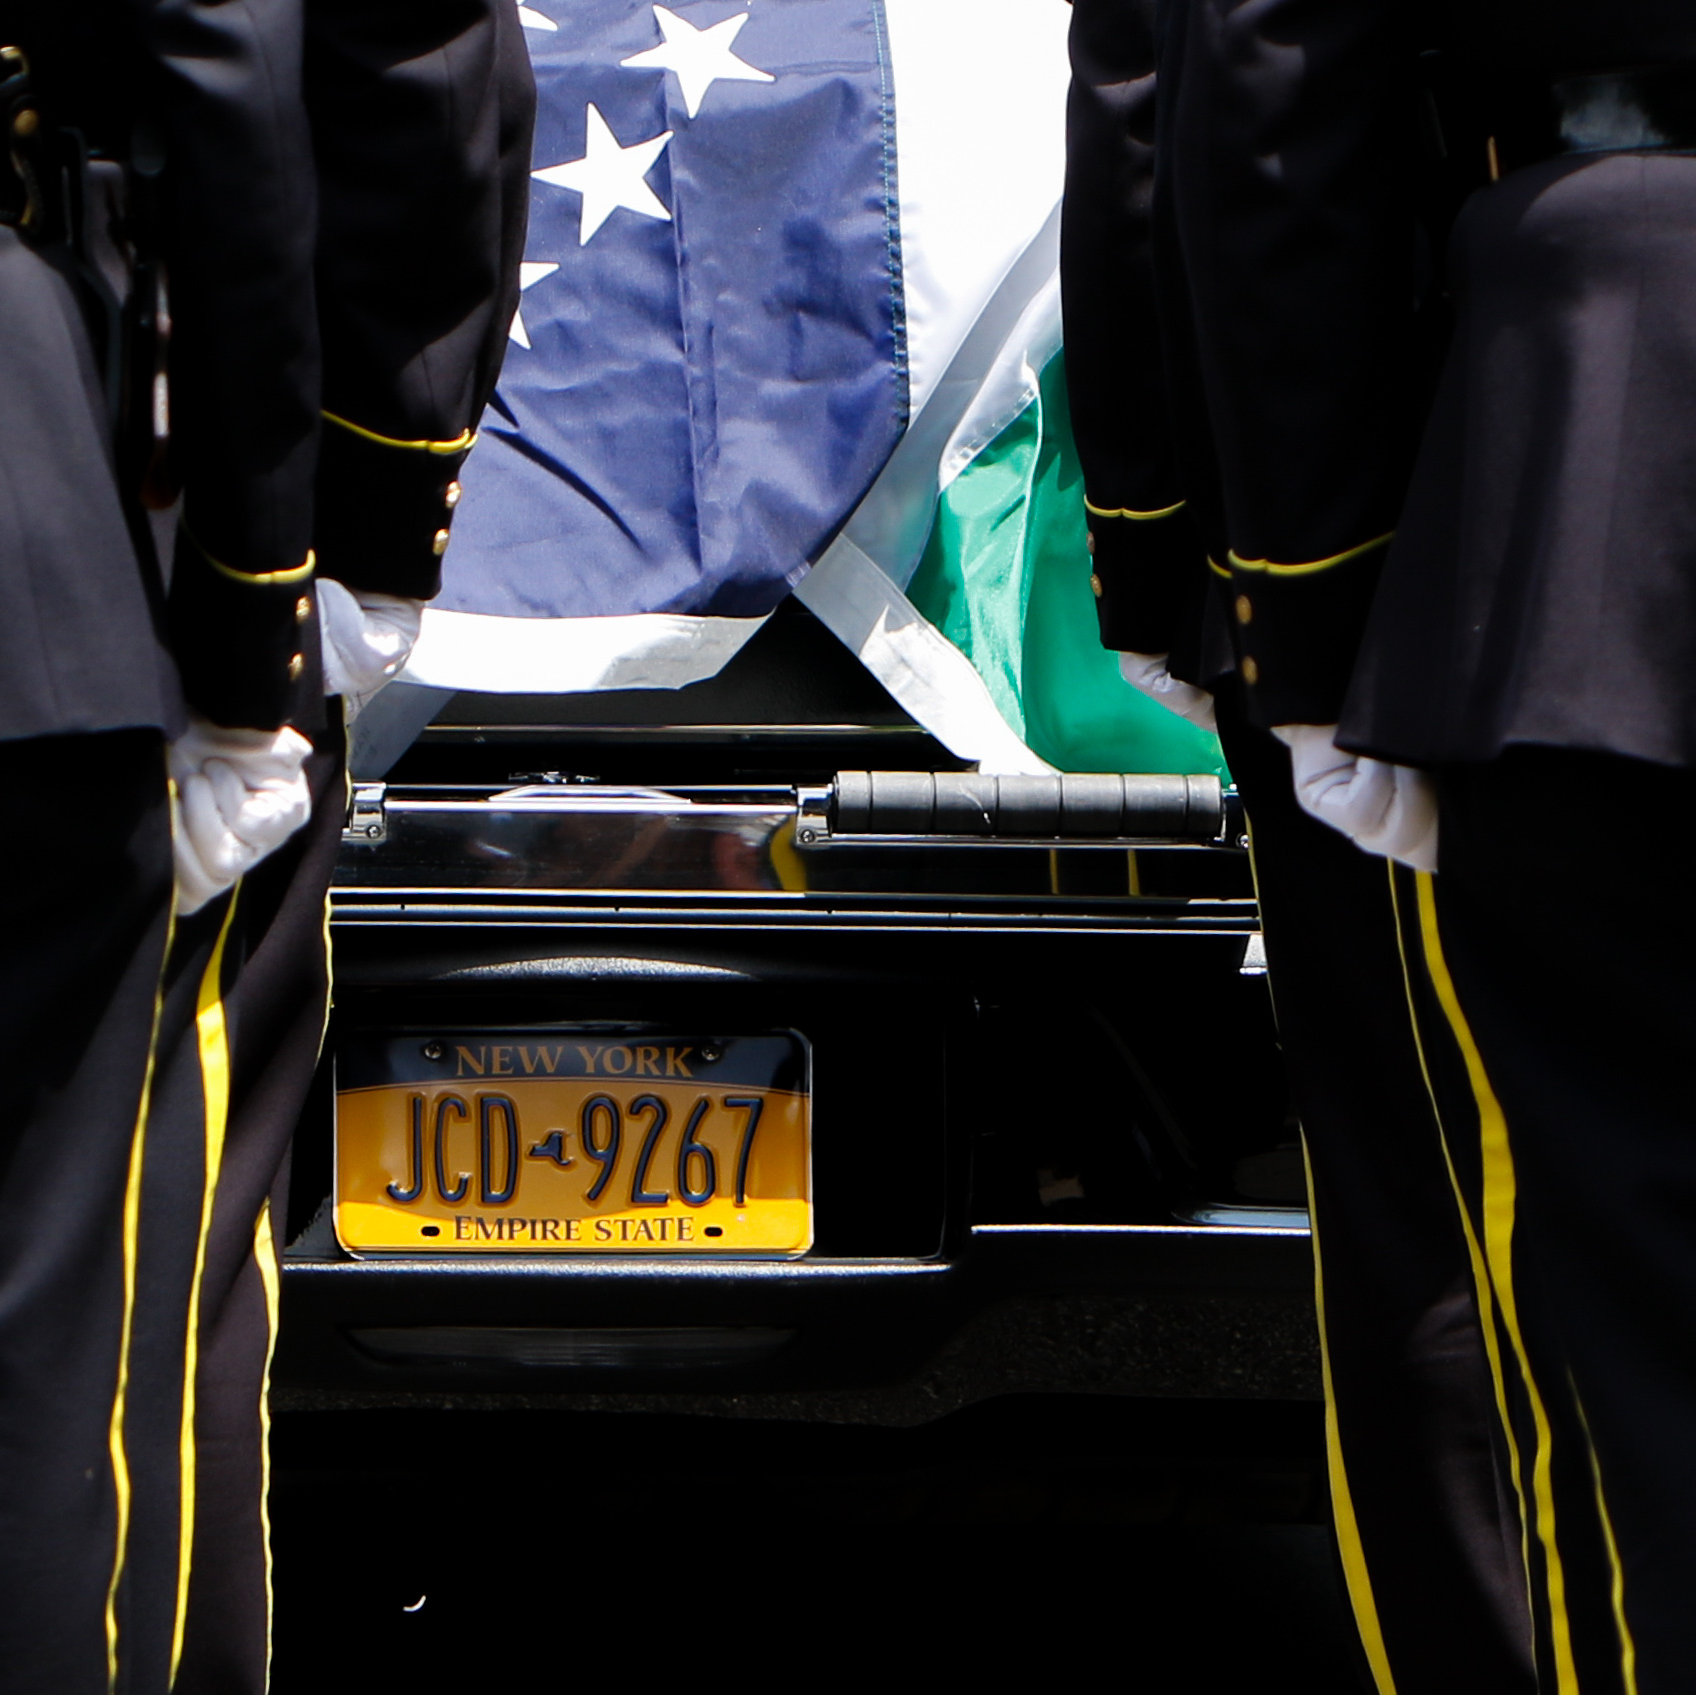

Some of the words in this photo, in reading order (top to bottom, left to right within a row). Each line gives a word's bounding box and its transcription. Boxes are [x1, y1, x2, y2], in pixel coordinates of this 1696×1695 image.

[455, 1045, 564, 1076] NEW
[577, 1045, 695, 1078] YORK
[386, 1096, 519, 1203] JCD
[581, 1095, 764, 1205] 9267
[454, 1215, 582, 1242] EMPIRE
[594, 1216, 695, 1242] STATE
